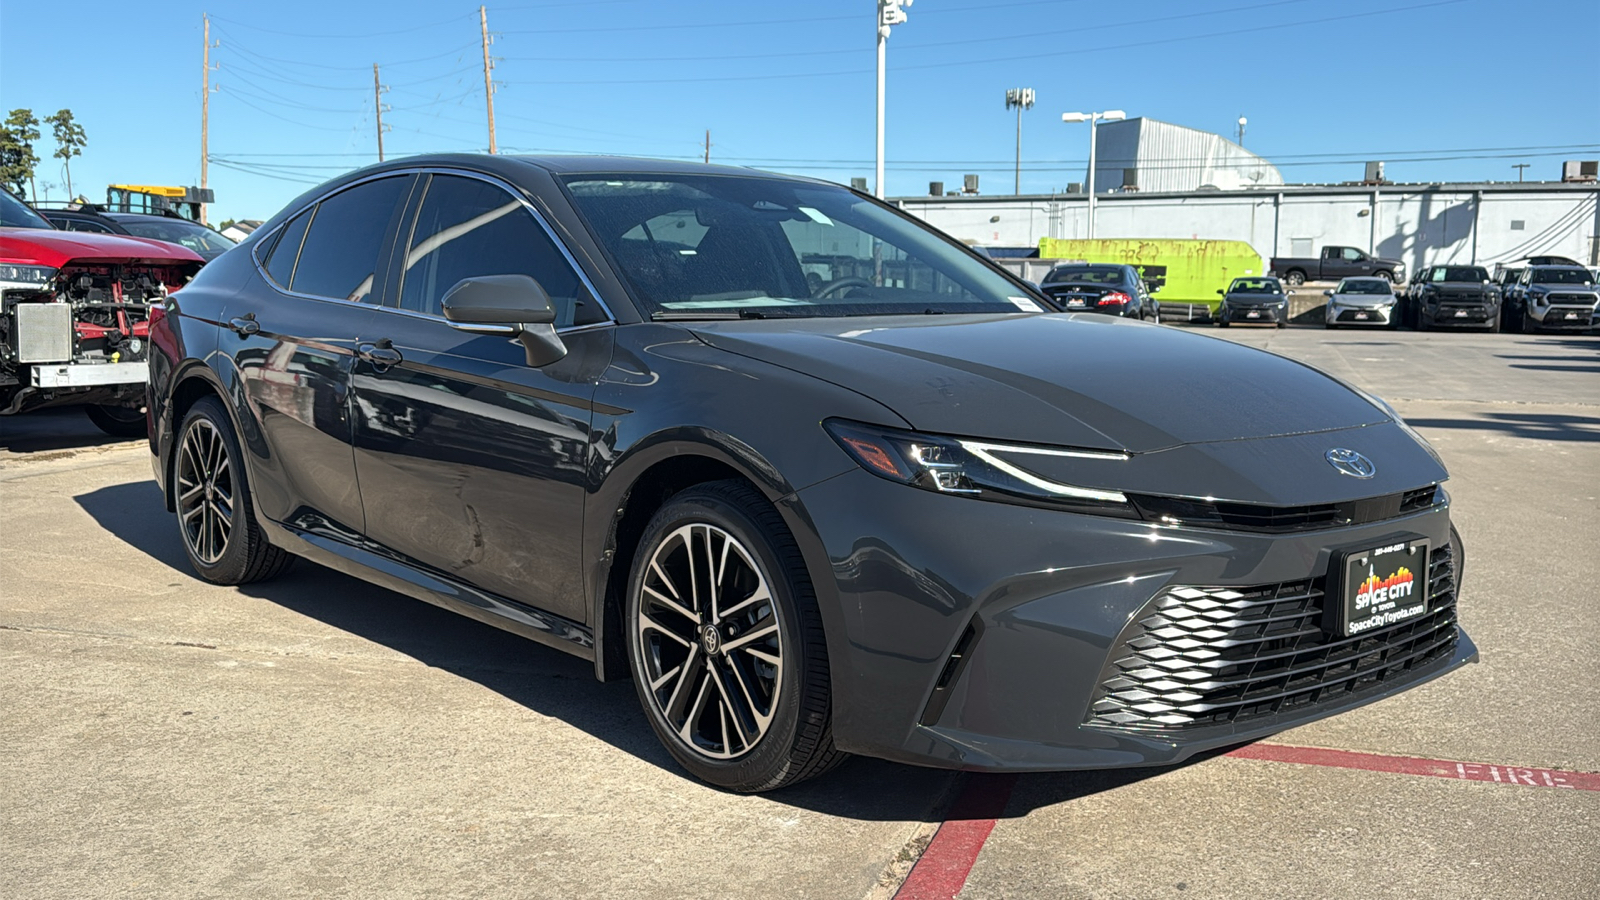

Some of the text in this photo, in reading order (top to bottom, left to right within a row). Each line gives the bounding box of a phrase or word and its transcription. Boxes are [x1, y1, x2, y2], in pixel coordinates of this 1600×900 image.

[1355, 580, 1414, 609] SPACE CITY
[1378, 601, 1396, 611] TOYOTA
[1349, 605, 1424, 634] SpaceCityToyota.com
[1456, 763, 1574, 788] FIRE
